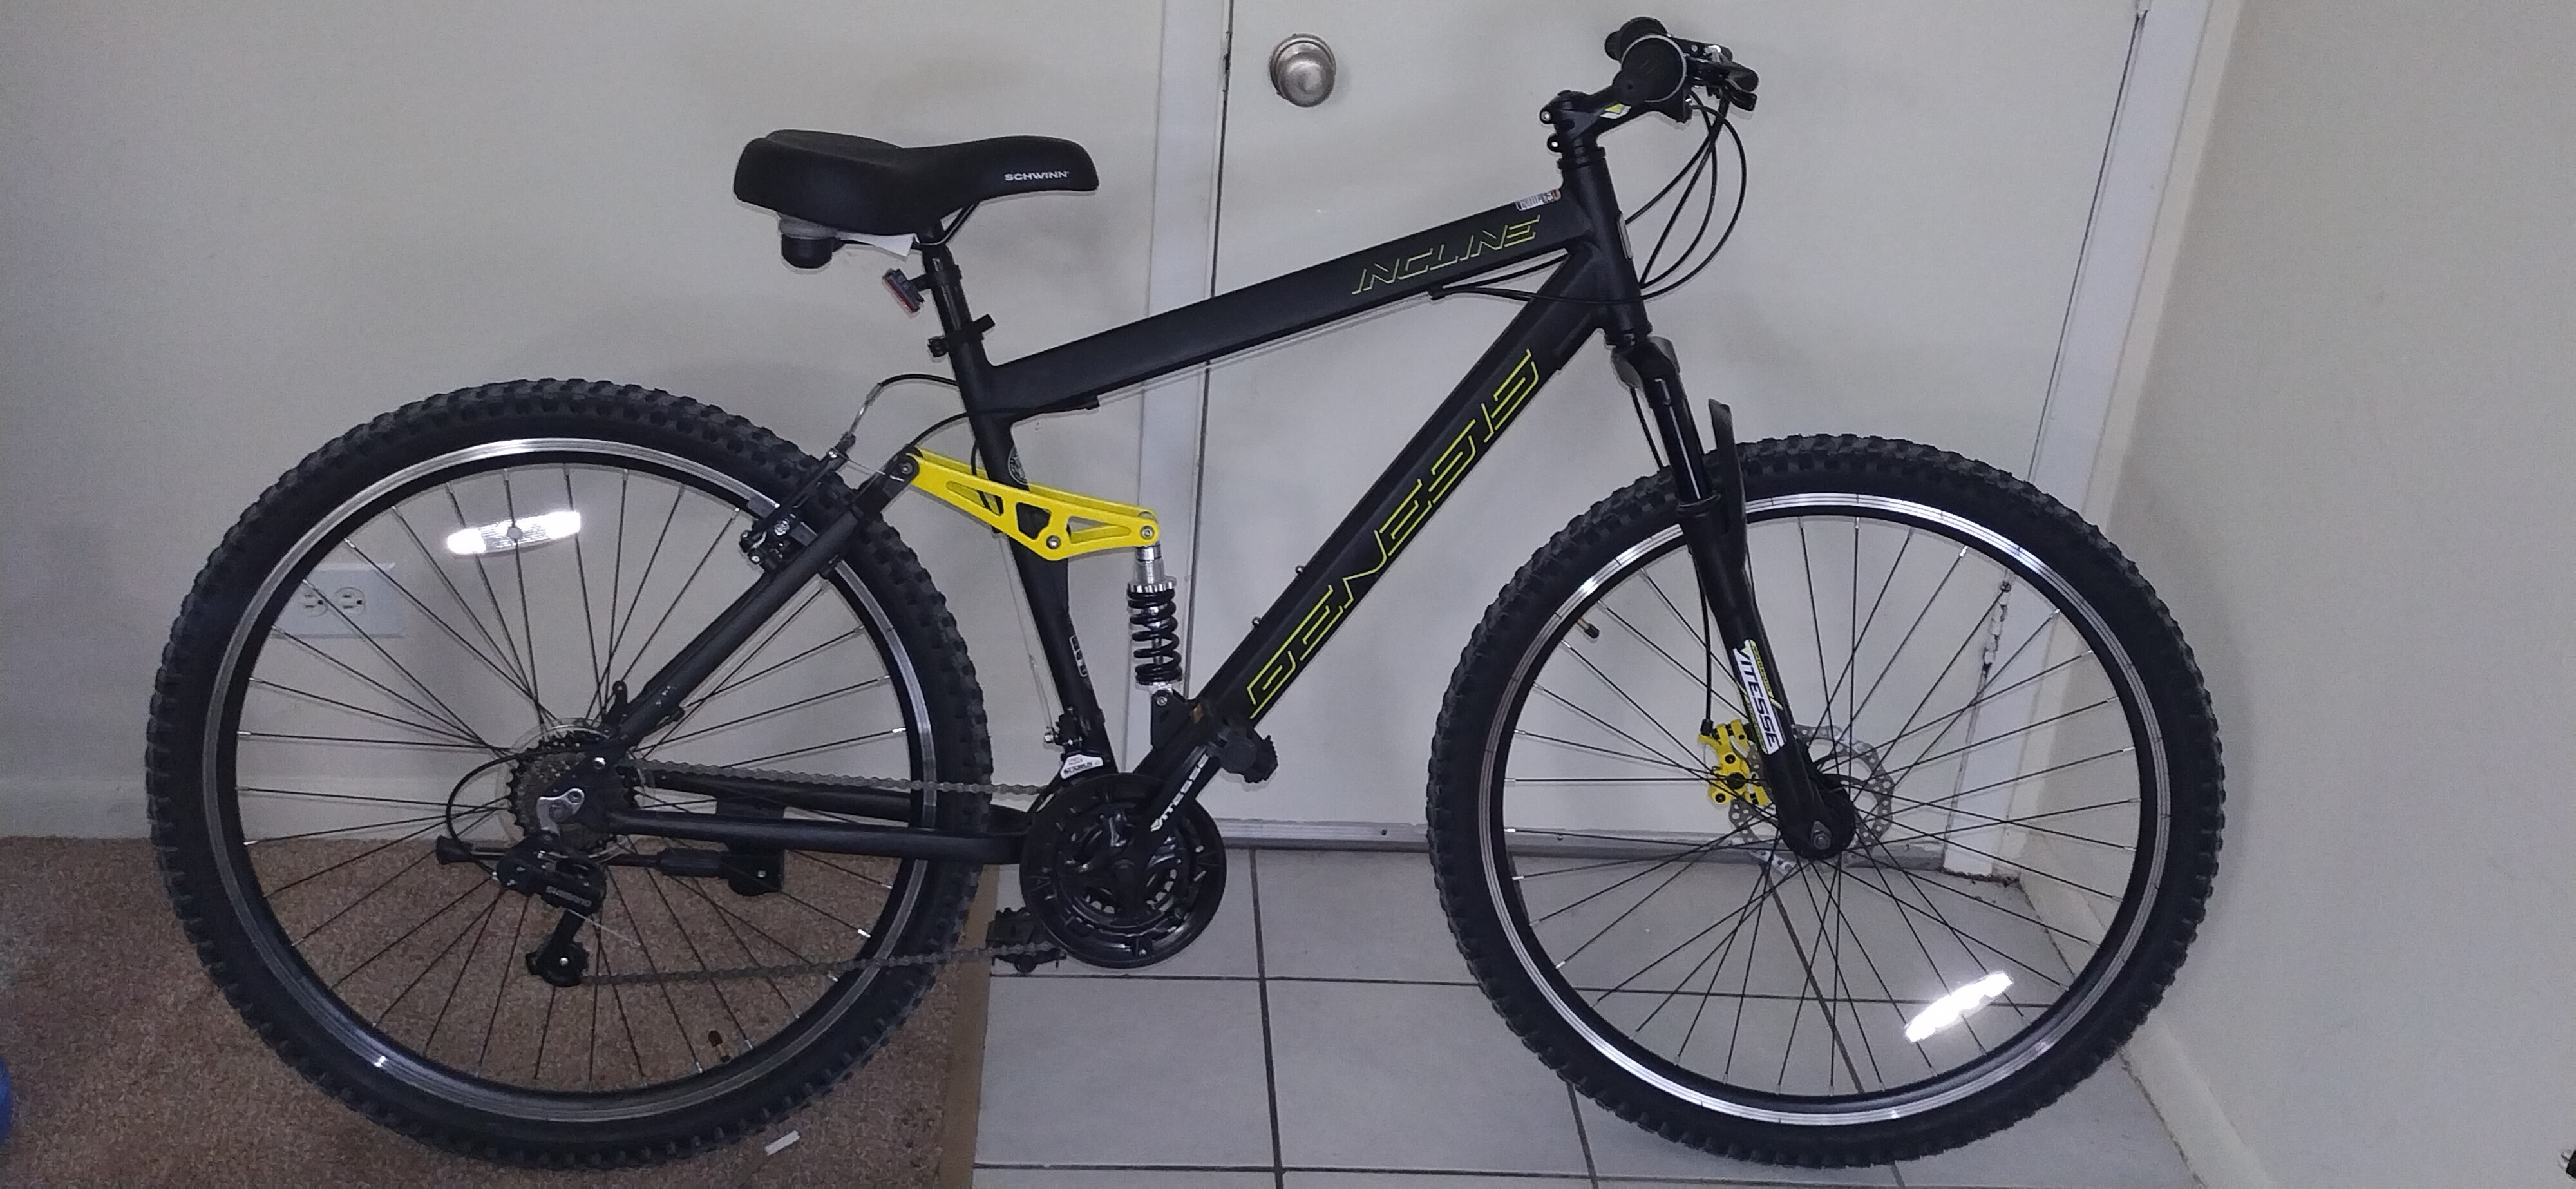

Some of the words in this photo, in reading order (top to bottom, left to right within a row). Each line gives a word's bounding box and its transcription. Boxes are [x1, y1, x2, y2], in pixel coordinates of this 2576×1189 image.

[1004, 171, 1068, 181] SCHWINN
[1352, 214, 1540, 295] INCLINE
[1246, 348, 1539, 719] GENESIS
[1737, 646, 1778, 747] VITESSE
